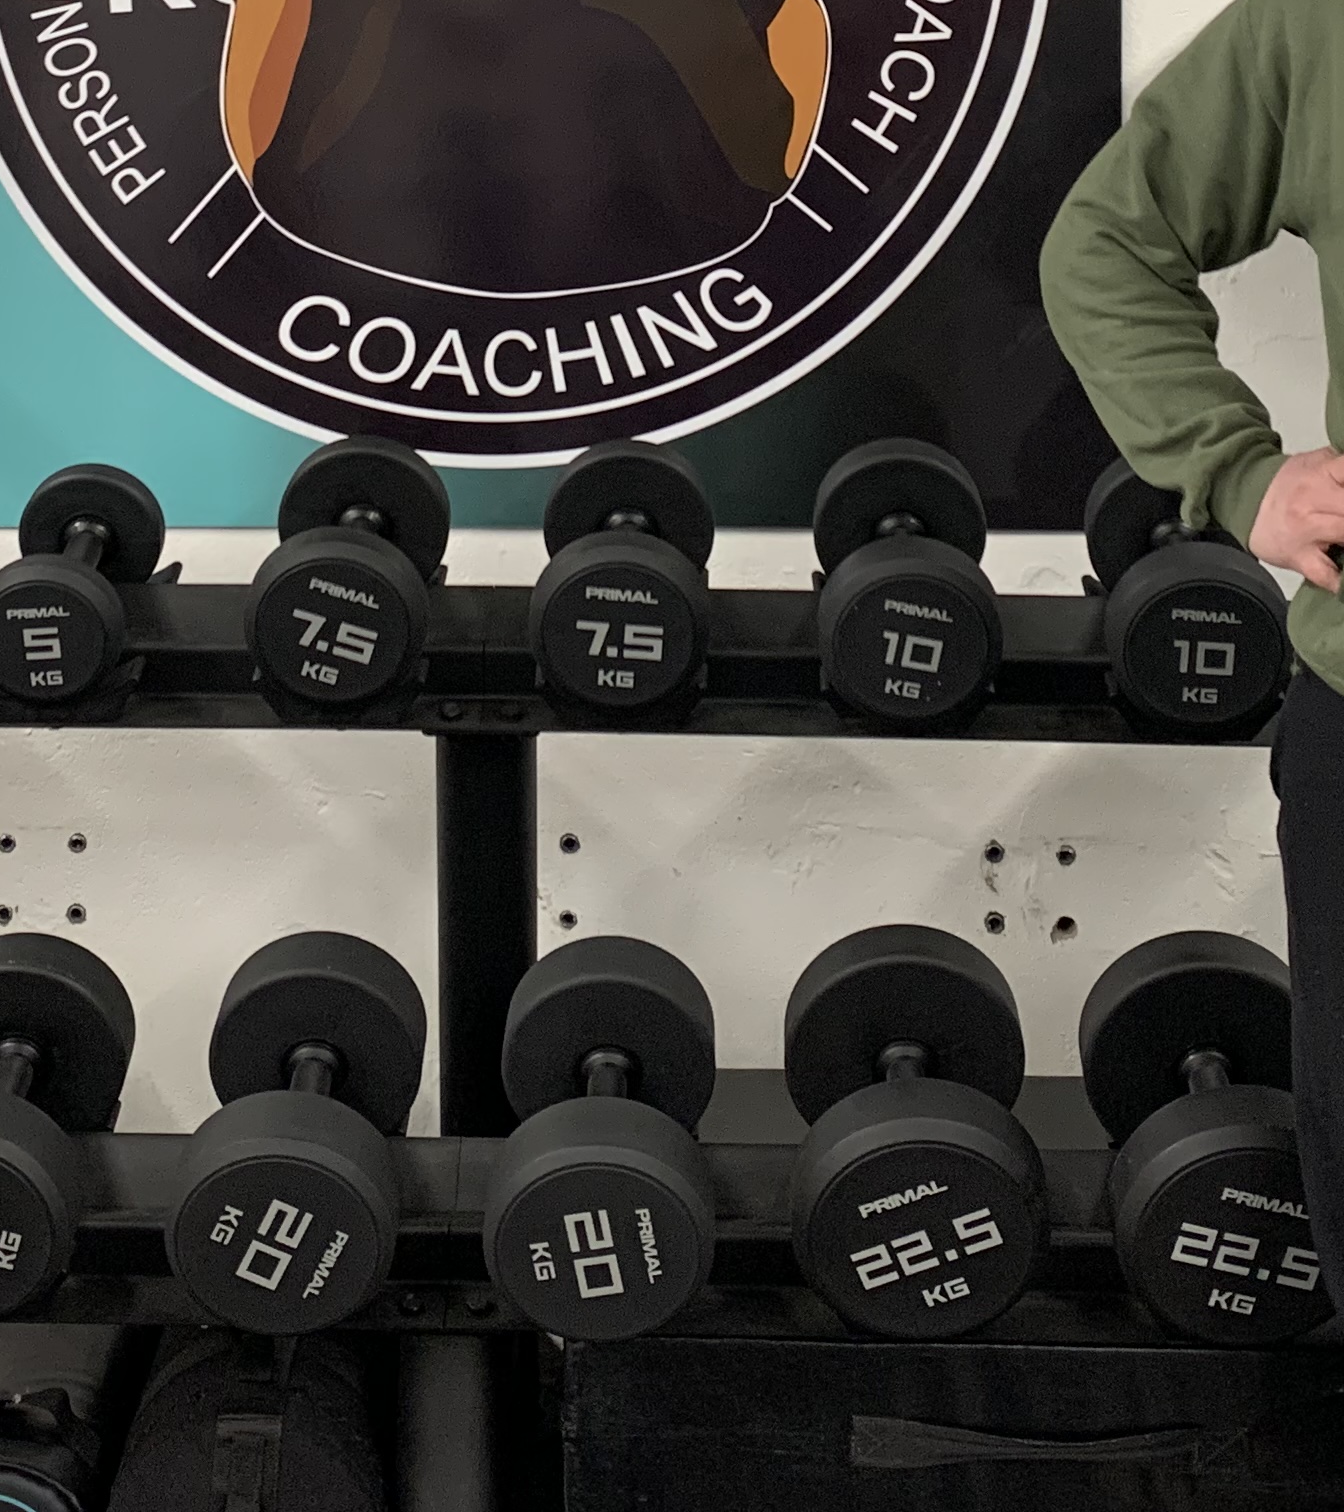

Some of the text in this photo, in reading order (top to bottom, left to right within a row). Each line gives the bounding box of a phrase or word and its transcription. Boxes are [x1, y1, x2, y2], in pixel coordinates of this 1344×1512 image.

[278, 267, 773, 396] COACHING
[309, 578, 379, 609] PRIMAL
[586, 587, 658, 604] PRIMAL
[884, 599, 953, 622] PRIMAL
[6, 607, 70, 619] PRIMAL
[1172, 609, 1242, 624] PRIMAL
[23, 627, 61, 660] 5
[293, 609, 378, 664] 7.5
[576, 620, 663, 661] 7.5
[884, 631, 943, 672] 10
[301, 661, 338, 685] KG
[1174, 640, 1235, 675] 10
[30, 671, 63, 686] KG
[598, 669, 634, 688] KG
[885, 678, 921, 698] KG
[1182, 687, 1218, 703] KG
[858, 1181, 948, 1218] PRIMAL
[1221, 1188, 1309, 1219] PRIMAL
[210, 1205, 243, 1245] KG
[236, 1199, 313, 1290] 20
[529, 1242, 556, 1280] KG
[564, 1210, 624, 1298] 20
[635, 1209, 662, 1283] PRIMAL
[850, 1208, 1003, 1290] 22.5
[1171, 1222, 1319, 1290] 22.5
[303, 1231, 348, 1298] PRIMAL
[922, 1277, 970, 1307] KG
[1208, 1289, 1256, 1314] KG
